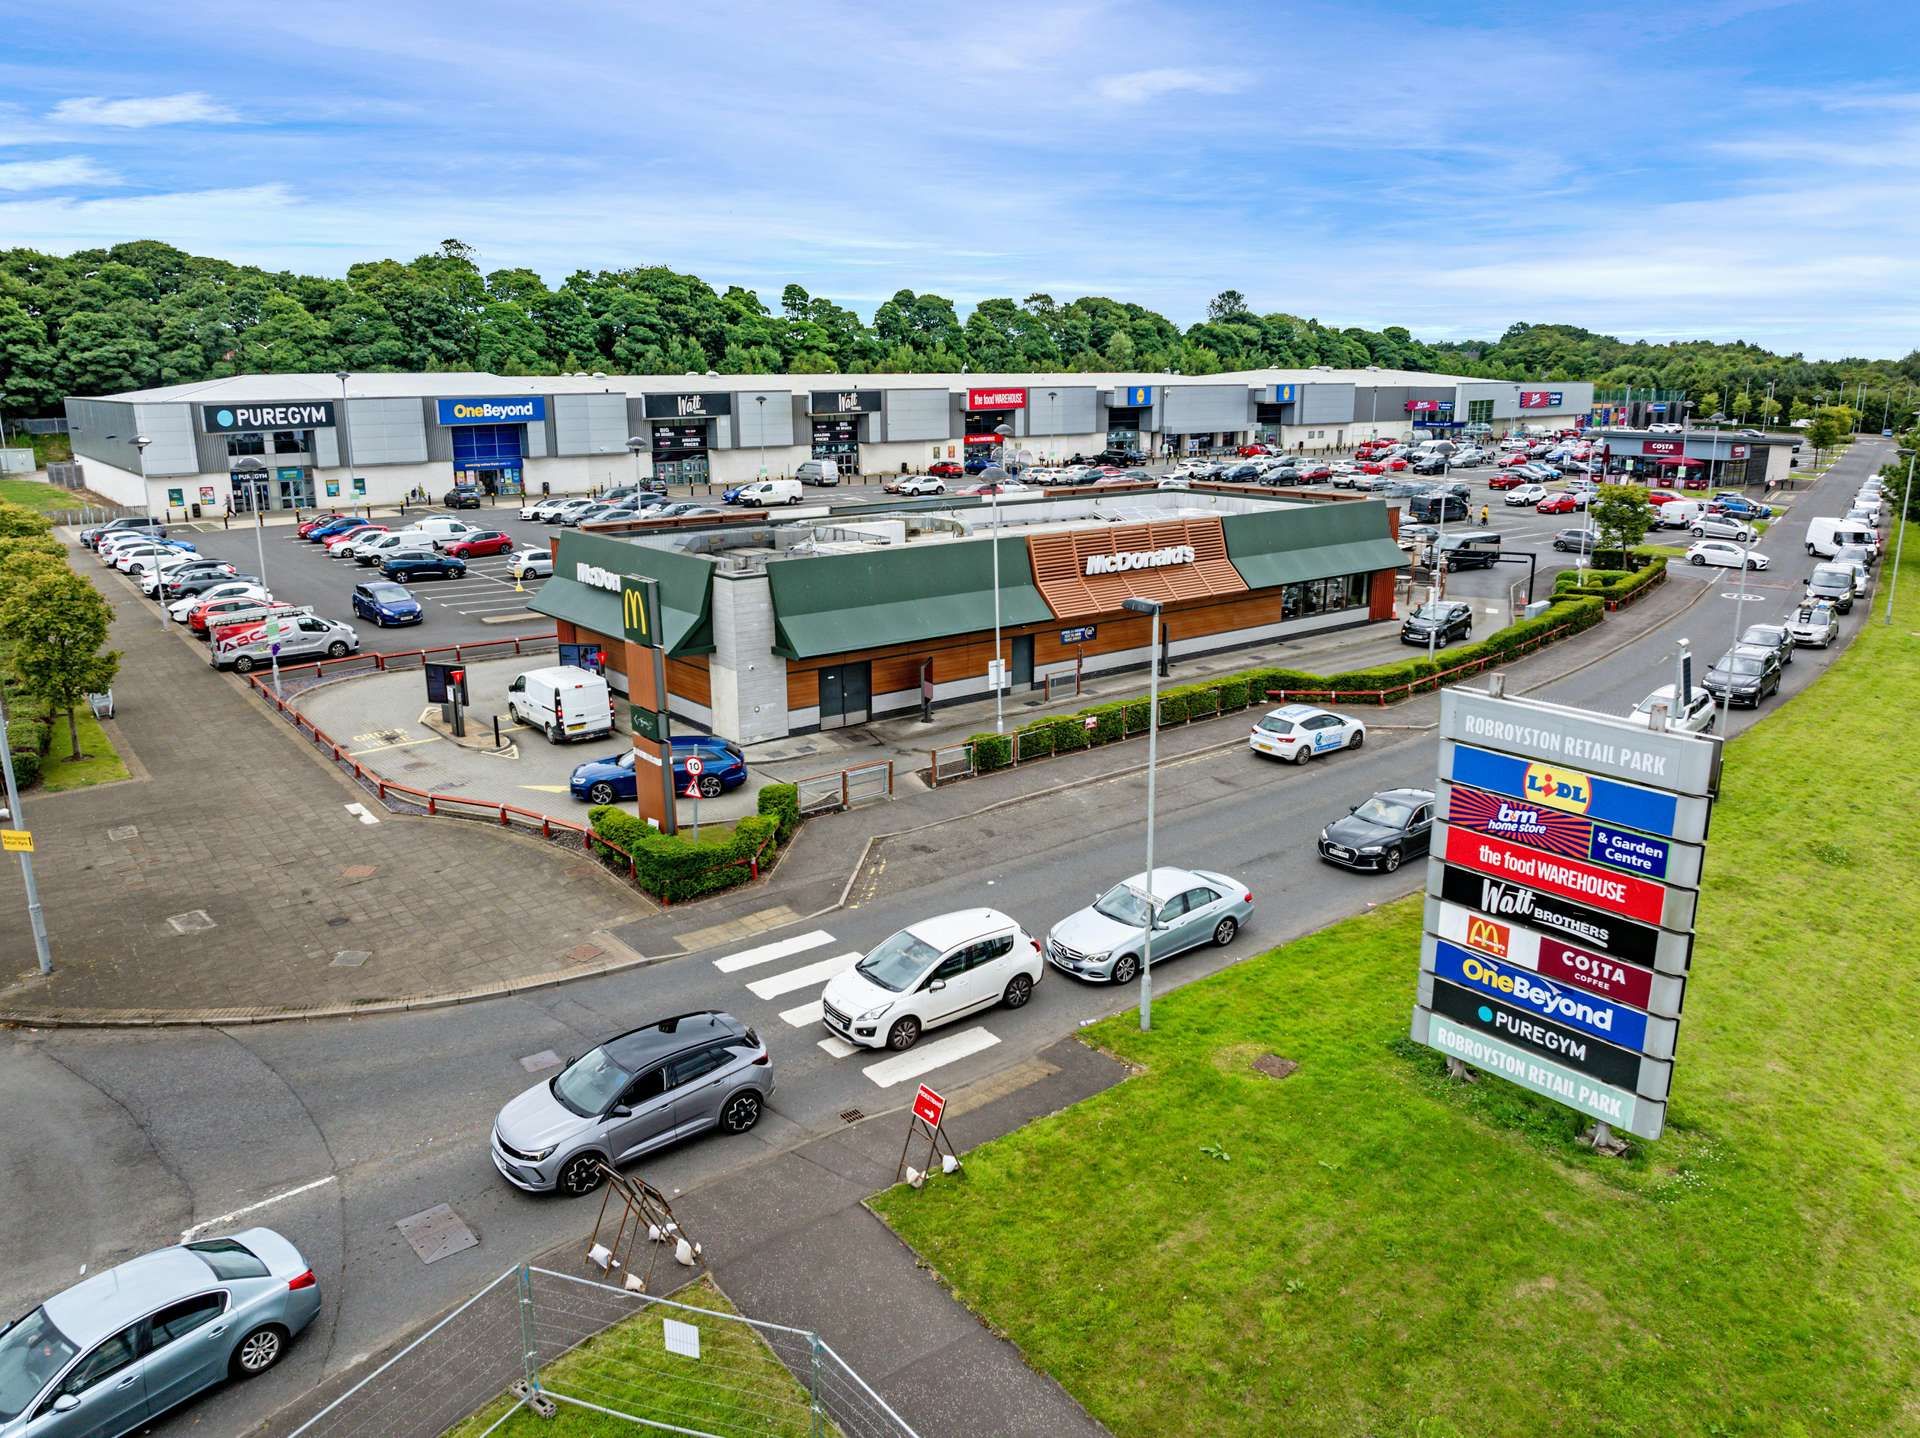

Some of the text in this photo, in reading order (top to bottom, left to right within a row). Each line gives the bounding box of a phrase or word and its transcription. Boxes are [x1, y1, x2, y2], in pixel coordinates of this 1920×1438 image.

[453, 402, 533, 419] OneBeyond
[678, 395, 702, 416] Watt
[838, 392, 858, 412] Watt
[974, 393, 1023, 405] the food WAREHOUSE
[236, 405, 327, 426] PUREGYM
[1086, 544, 1195, 576] McDonald's
[1465, 715, 1666, 776] ROBROYSTON RETAIL PARK
[689, 762, 700, 771] 10
[1488, 819, 1547, 835] home store
[1597, 832, 1663, 859] & Garden
[1605, 847, 1651, 869] Centre
[1479, 845, 1627, 904] the food WAREHOUSE
[1481, 878, 1609, 941] Watt BROTHERS
[1562, 950, 1626, 985] COSTA
[1574, 972, 1610, 990] COFFEE
[1462, 958, 1613, 1032] OneBeyond
[1495, 1011, 1586, 1061] PUREGYM
[1438, 1027, 1621, 1118] ROBROYSTON RETAIL PARK
